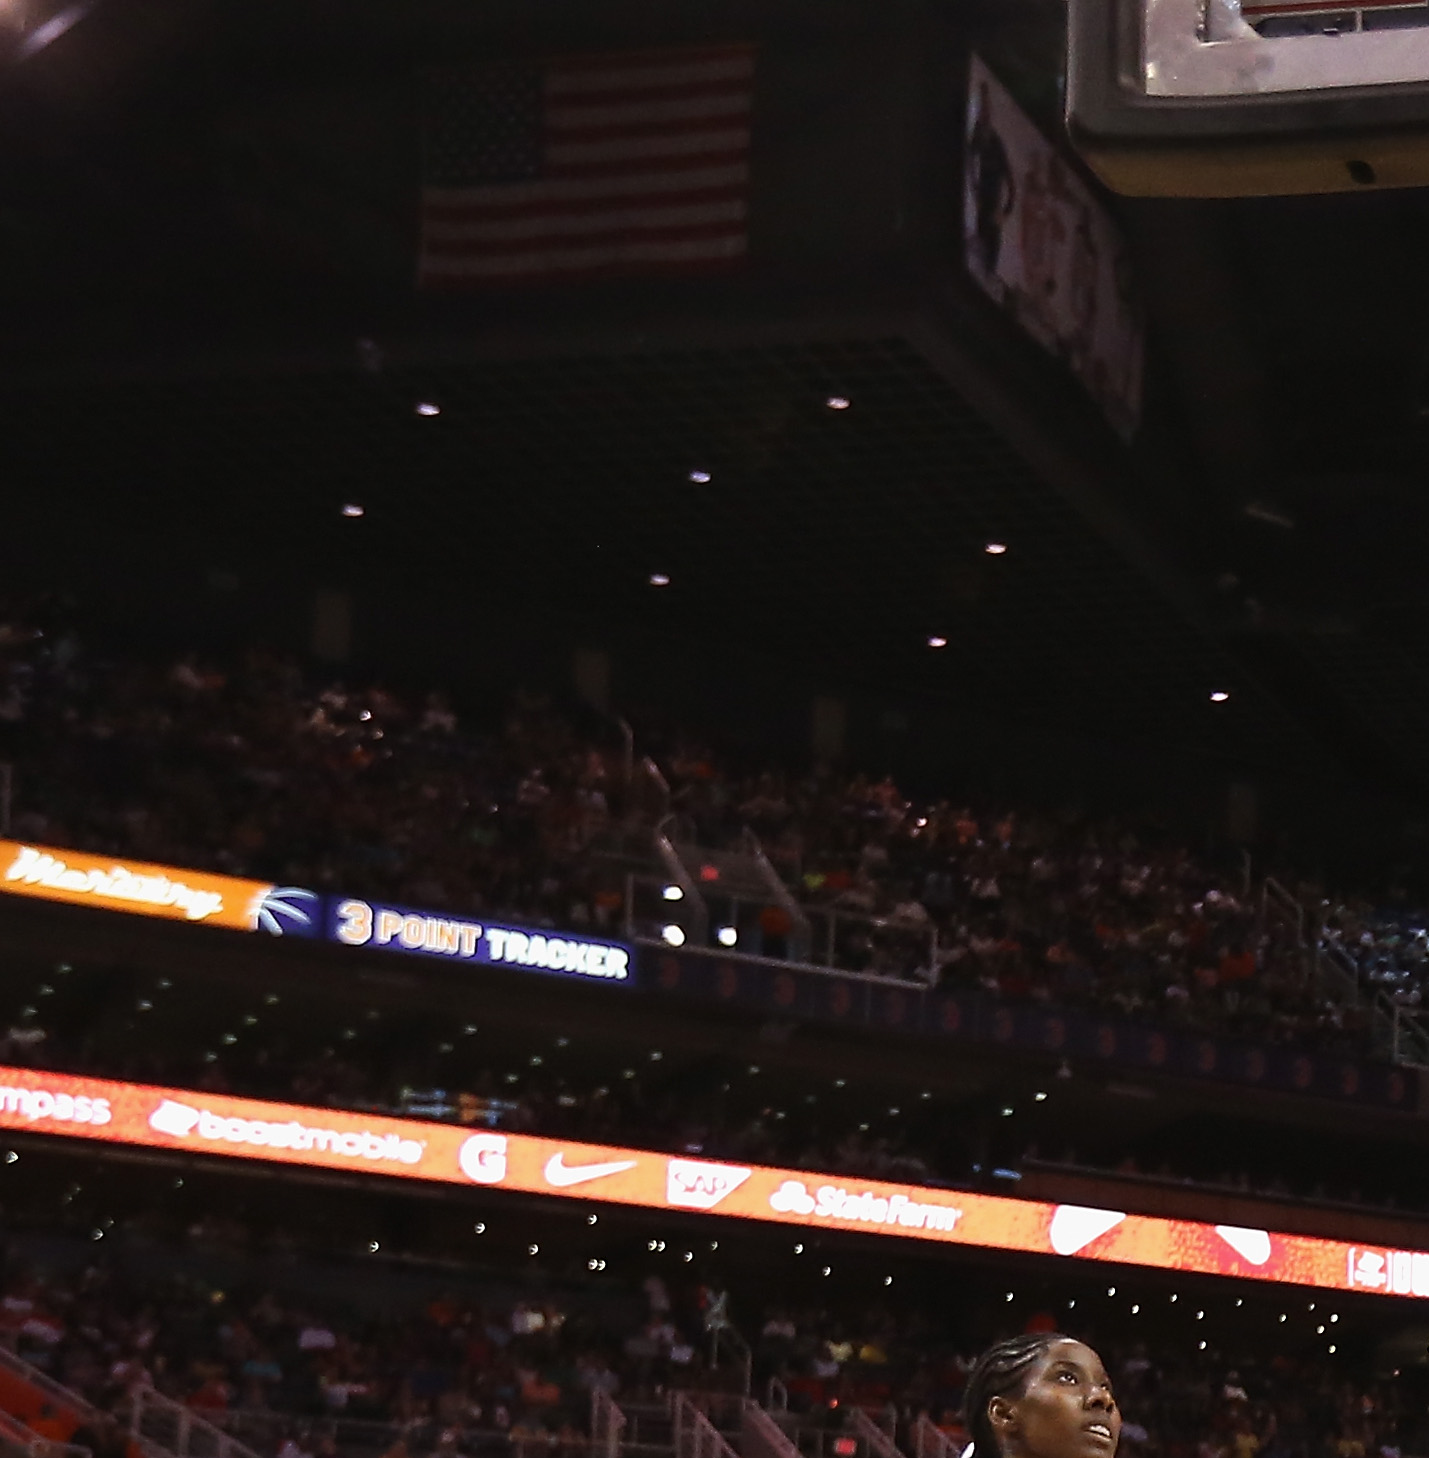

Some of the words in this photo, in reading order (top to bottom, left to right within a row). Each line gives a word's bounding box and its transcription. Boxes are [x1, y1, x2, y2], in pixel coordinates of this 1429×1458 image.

[337, 900, 373, 946] 3
[378, 908, 482, 957] POINT
[485, 928, 630, 980] TRACKER
